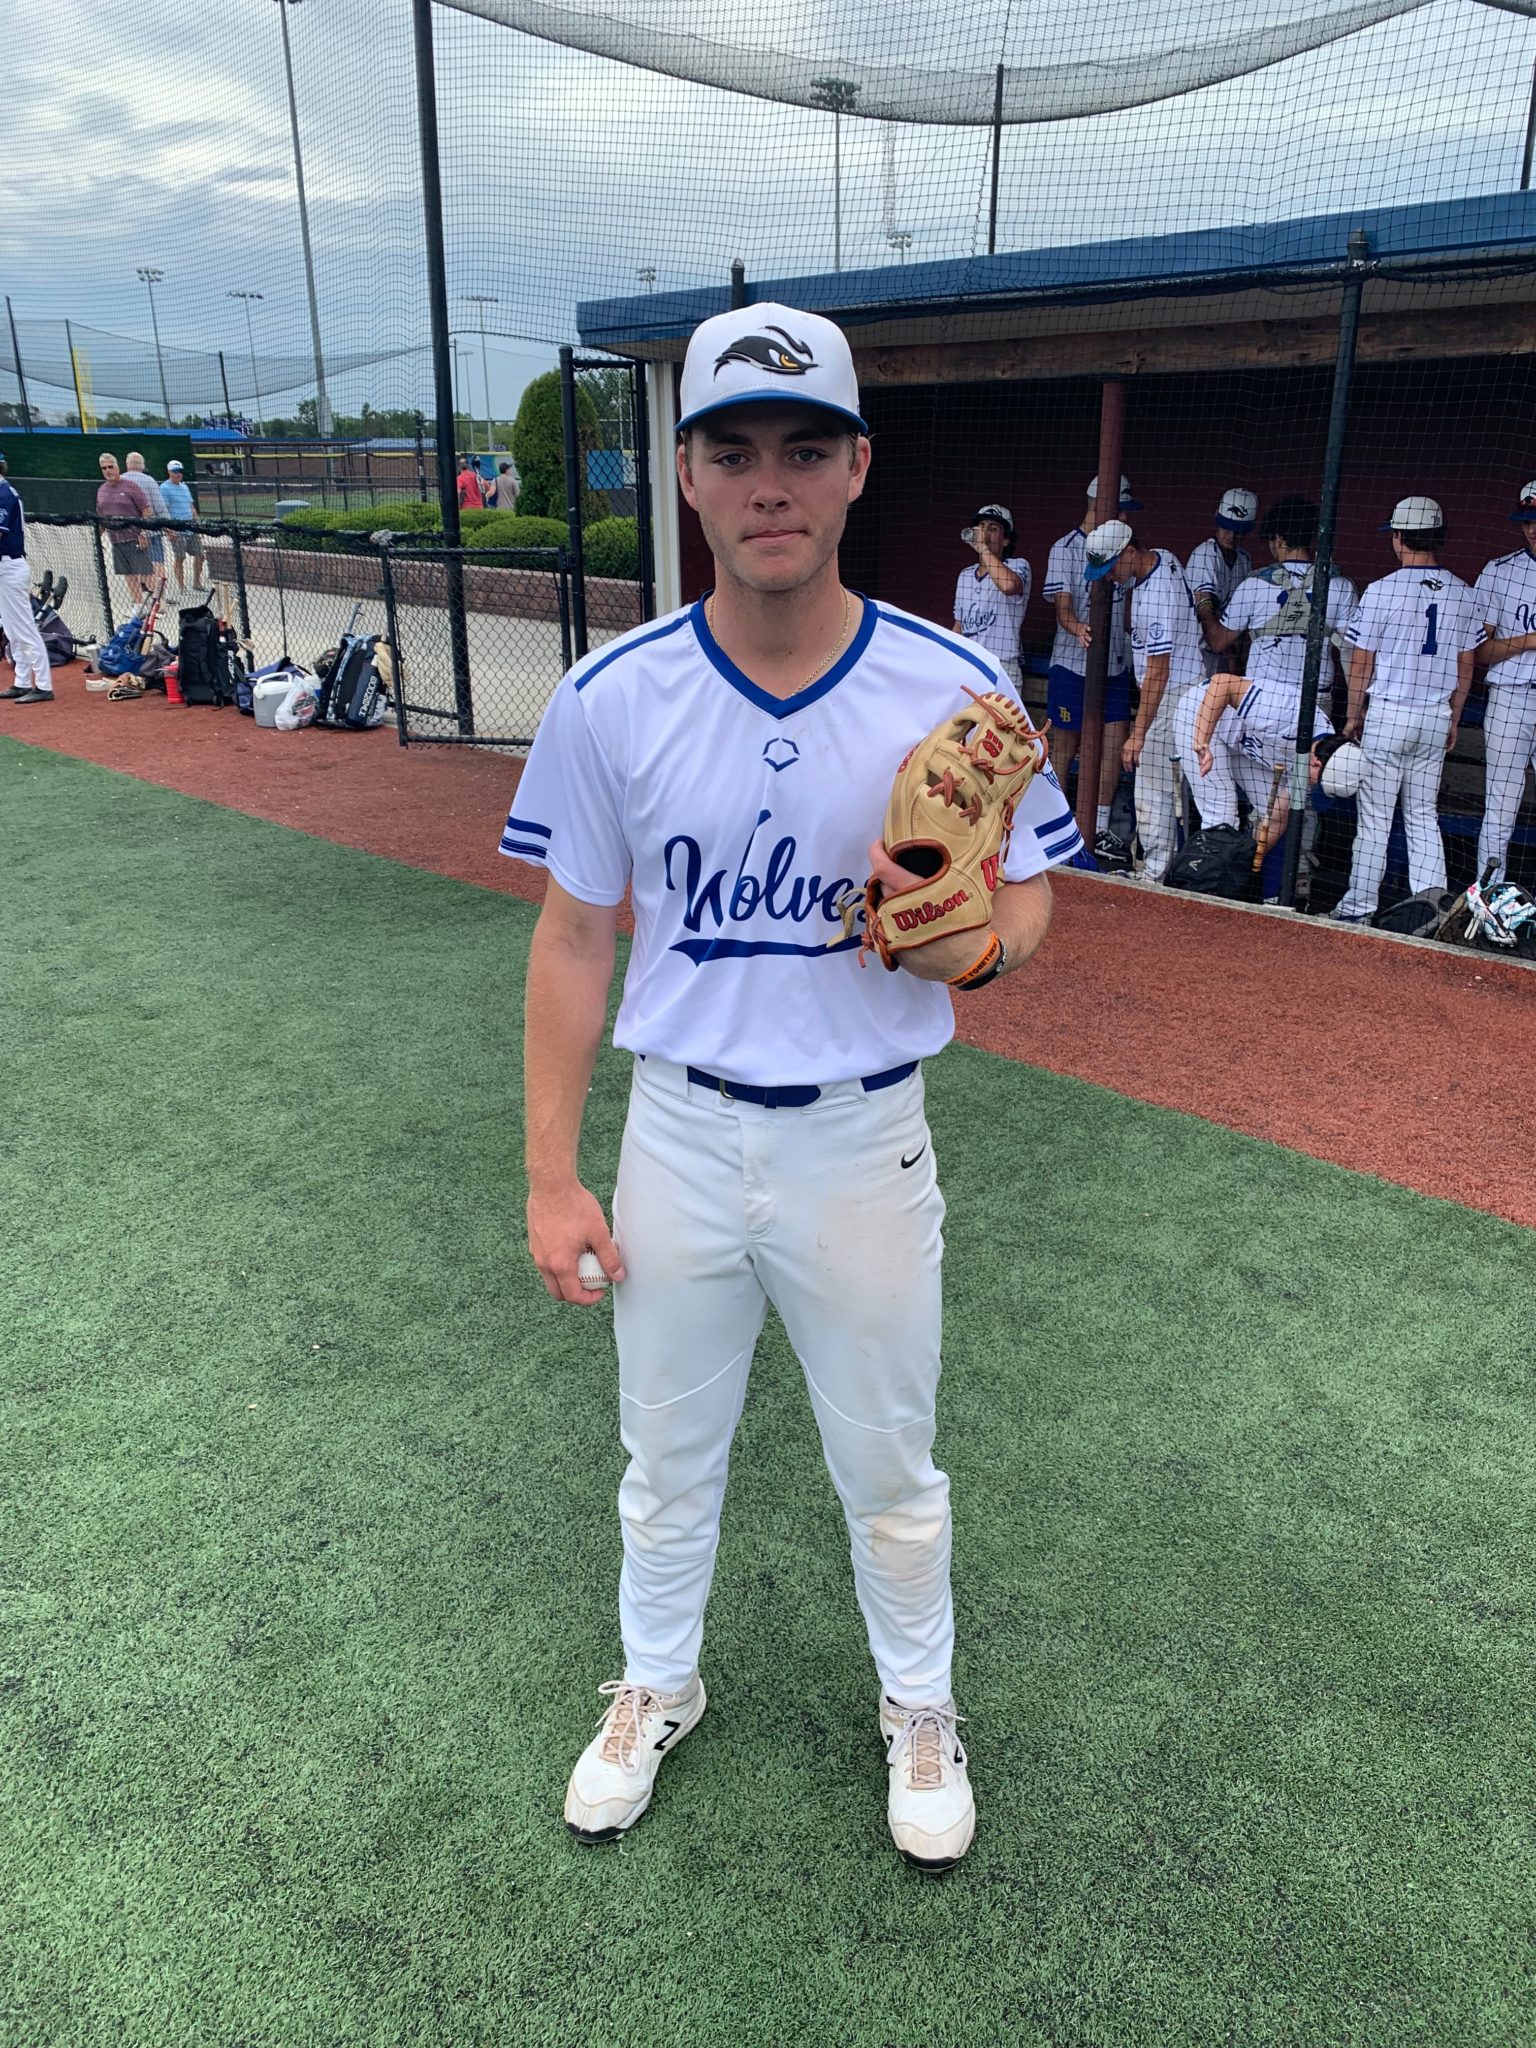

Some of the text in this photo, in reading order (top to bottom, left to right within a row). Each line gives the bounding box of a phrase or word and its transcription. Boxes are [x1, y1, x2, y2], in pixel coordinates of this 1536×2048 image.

[1421, 603, 1438, 655] 1
[664, 809, 867, 932] Wolve
[892, 889, 970, 932] Wilson
[967, 942, 998, 977] TOGETHER
